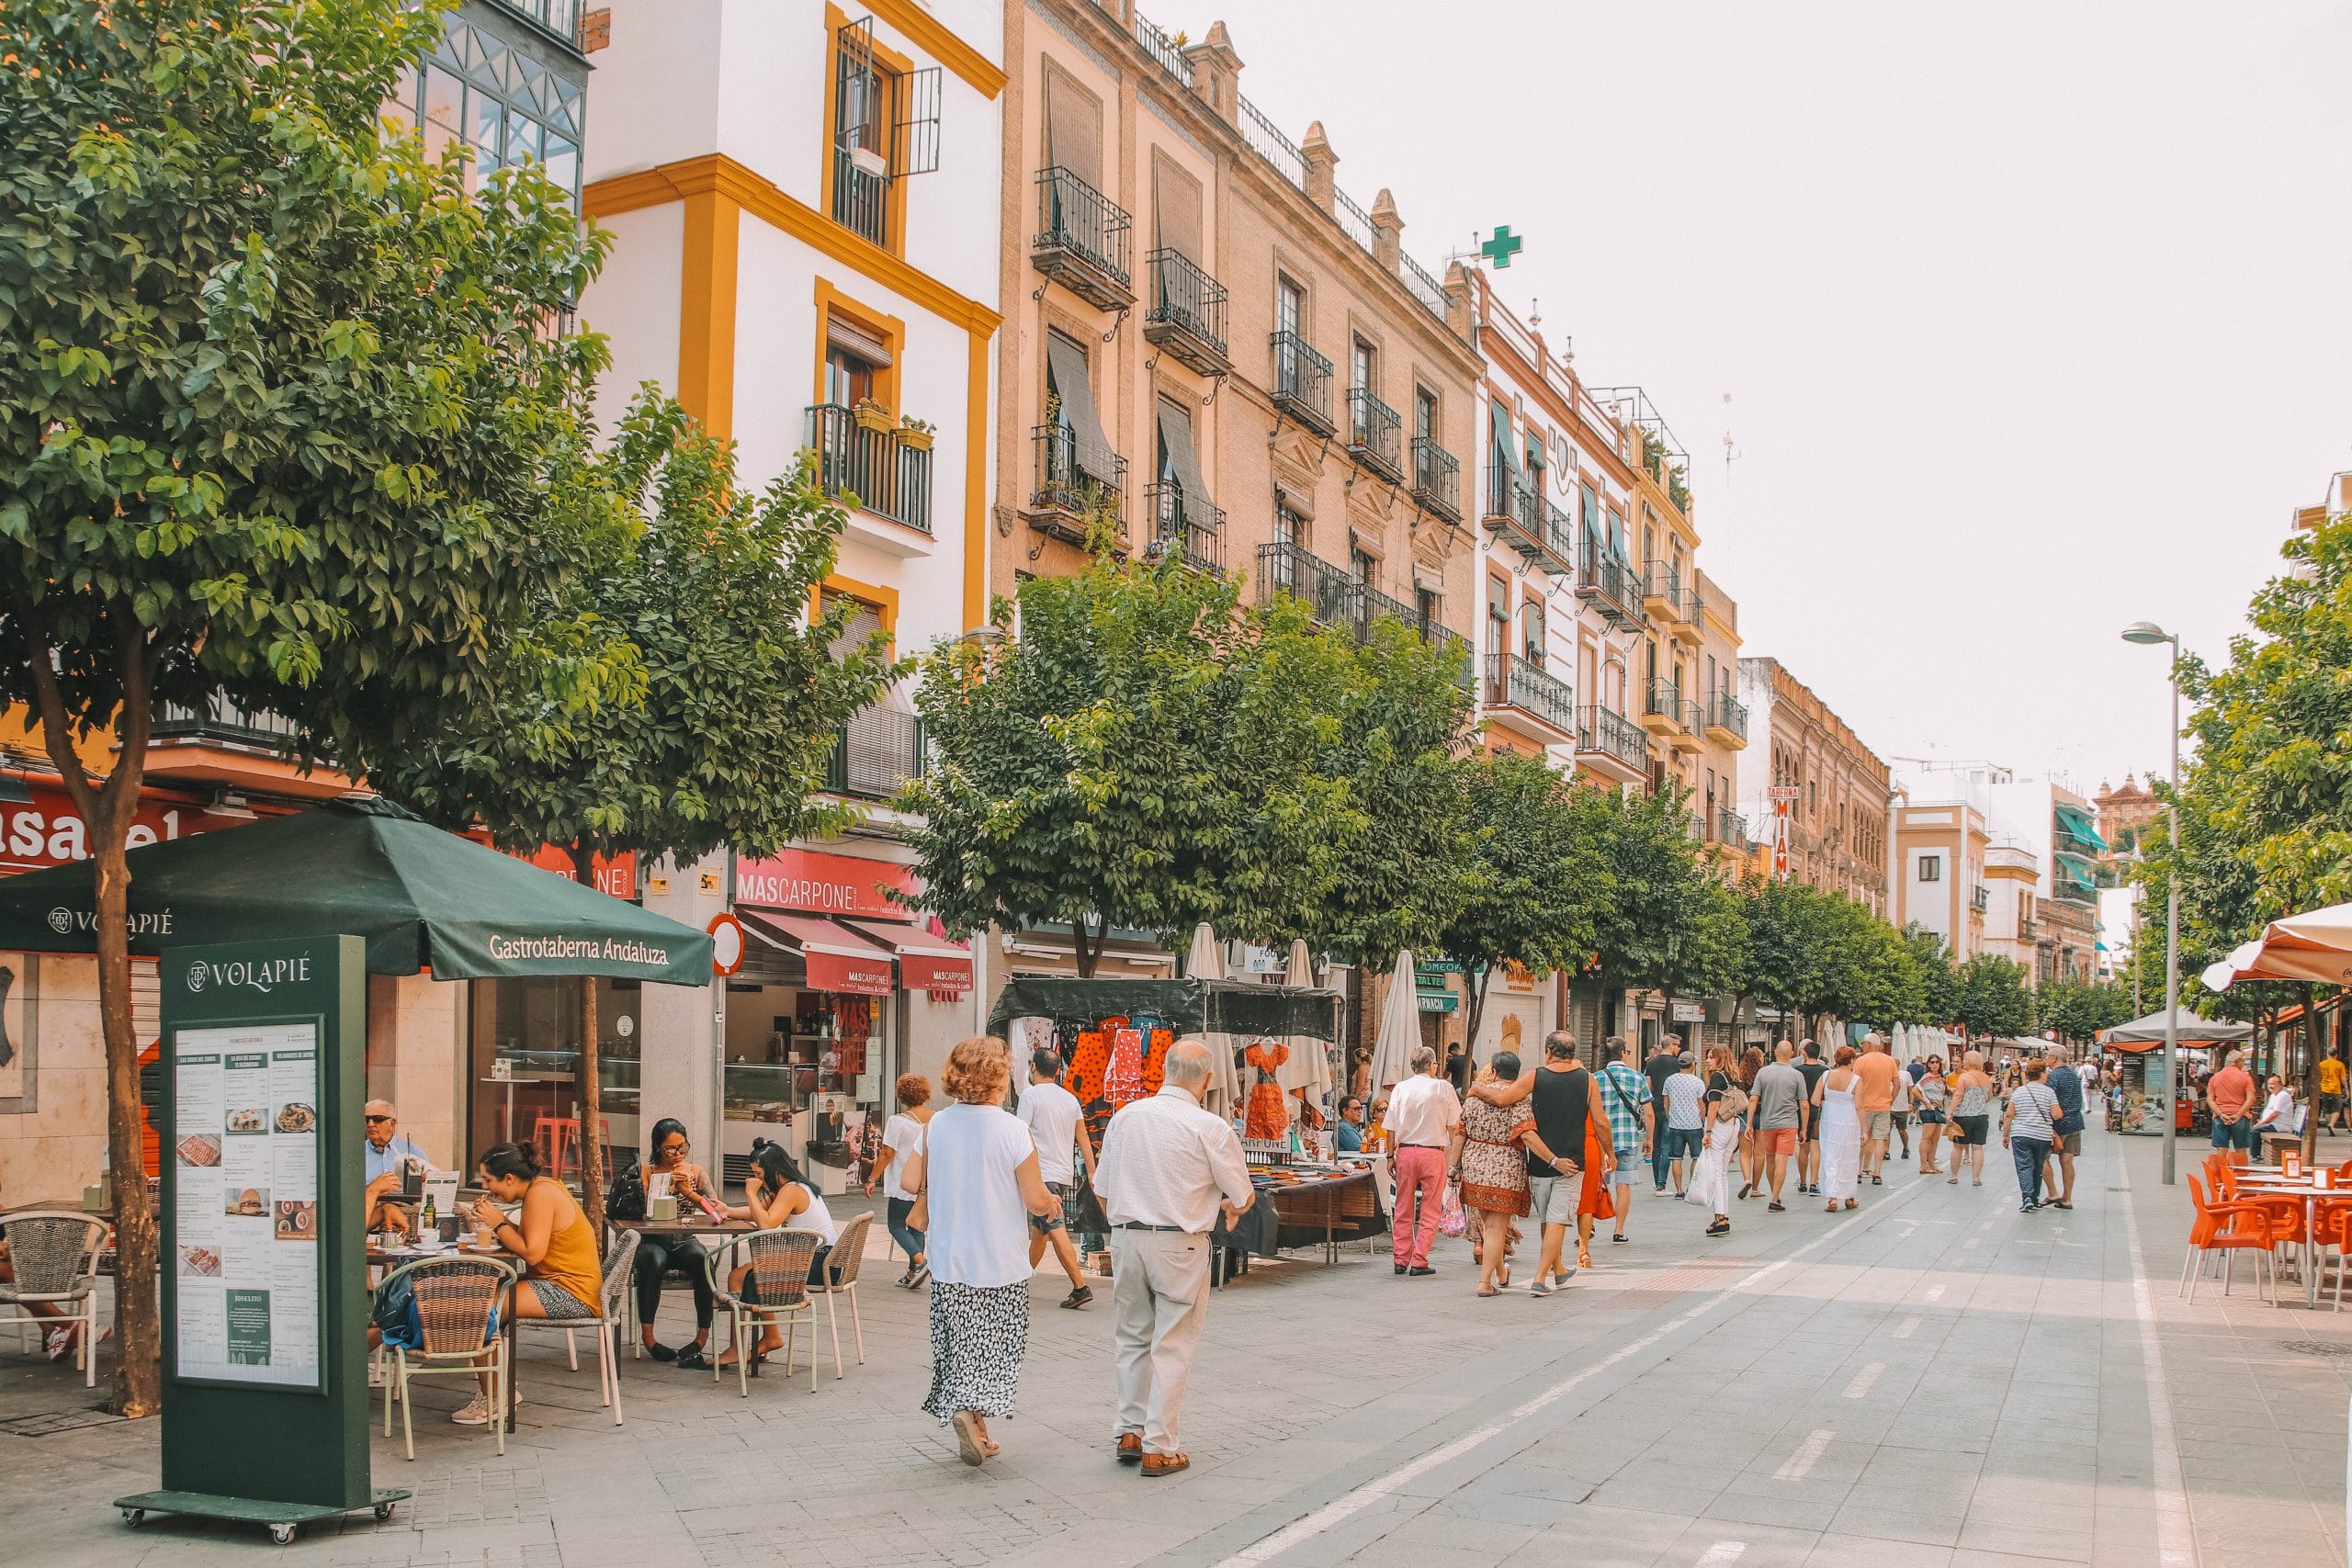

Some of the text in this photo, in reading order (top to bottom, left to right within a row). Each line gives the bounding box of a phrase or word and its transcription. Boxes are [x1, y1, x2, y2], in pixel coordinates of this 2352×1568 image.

[1769, 787, 1798, 798] TABERNA
[1776, 800, 1788, 889] MIAMI
[738, 874, 854, 910] MASCARPONE
[76, 908, 173, 942] VAPIÉ
[489, 934, 670, 965] Gastrotaberna Andaluza
[212, 950, 311, 993] VOLAPIÉ
[848, 971, 886, 985] MASCARPONE
[933, 970, 967, 982] MASCARPONE
[1418, 997, 1444, 1010] ARMACIA
